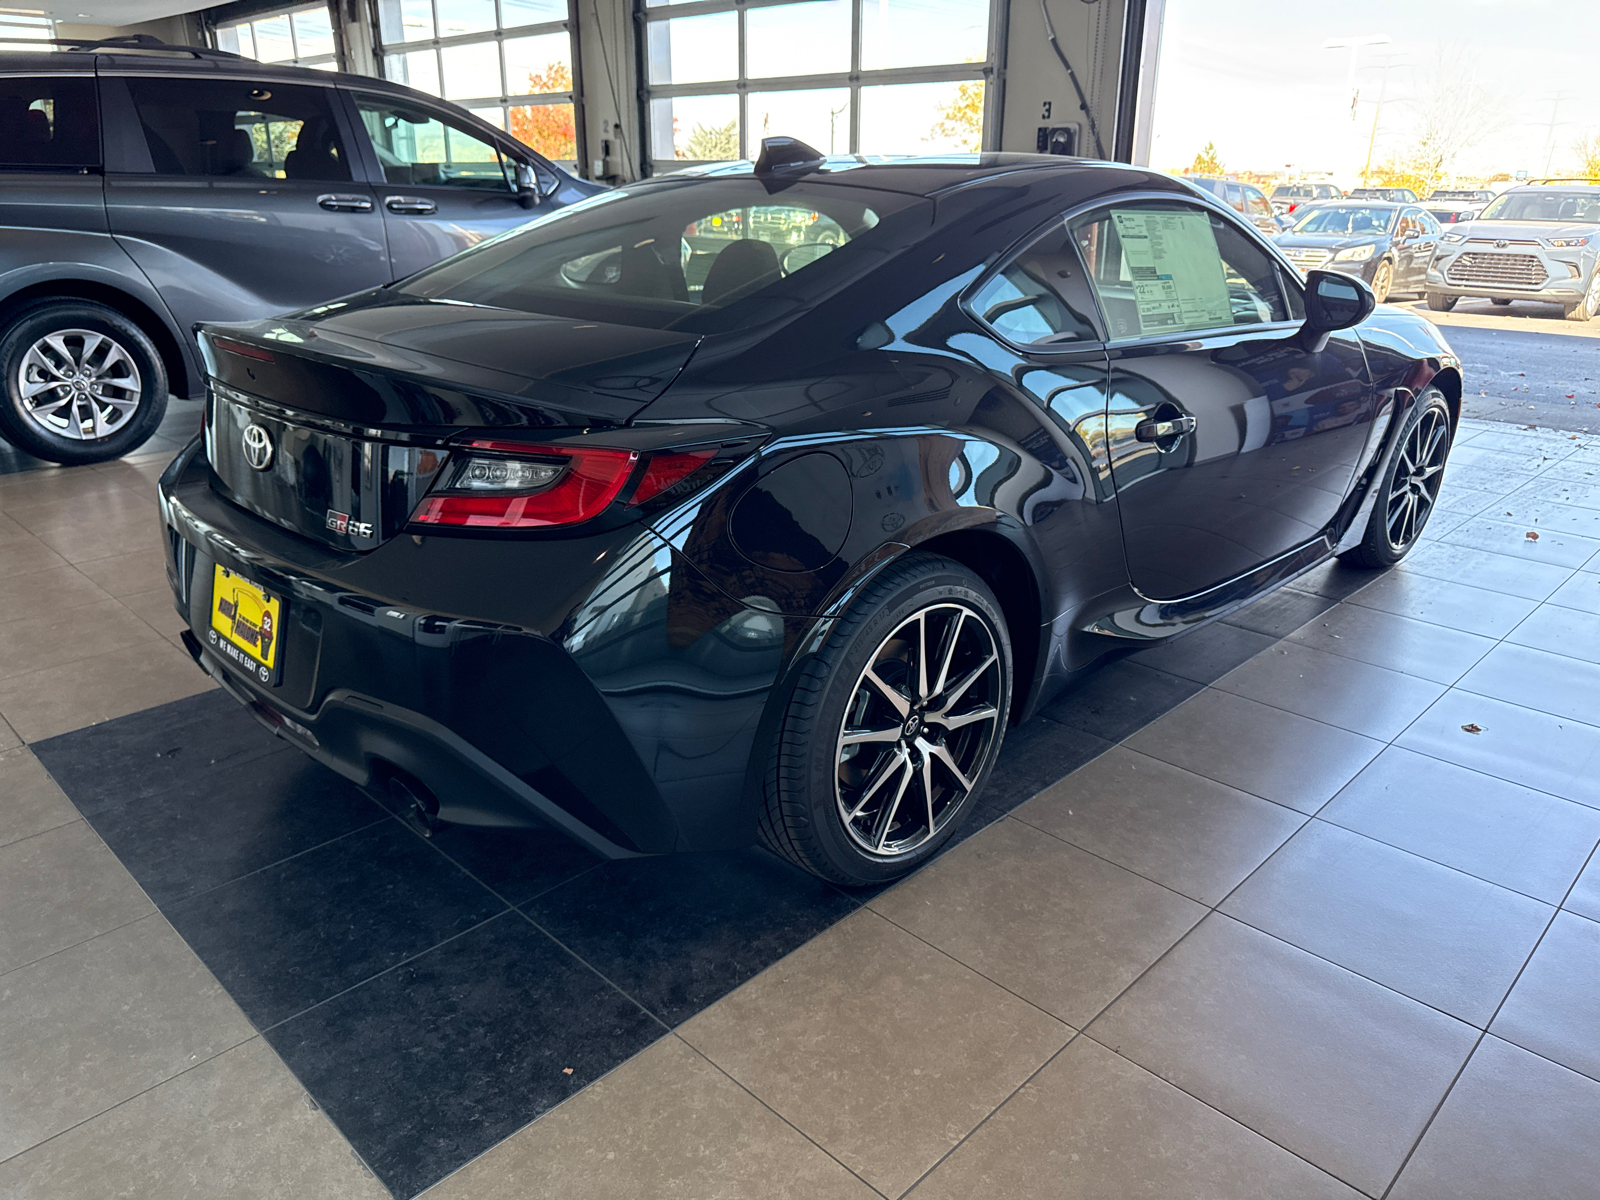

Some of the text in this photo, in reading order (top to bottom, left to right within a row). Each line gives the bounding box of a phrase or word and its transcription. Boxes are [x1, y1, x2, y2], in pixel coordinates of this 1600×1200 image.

[1042, 101, 1051, 119] 3
[603, 120, 609, 133] 2
[219, 638, 257, 673] WE MAKE IT EASY
